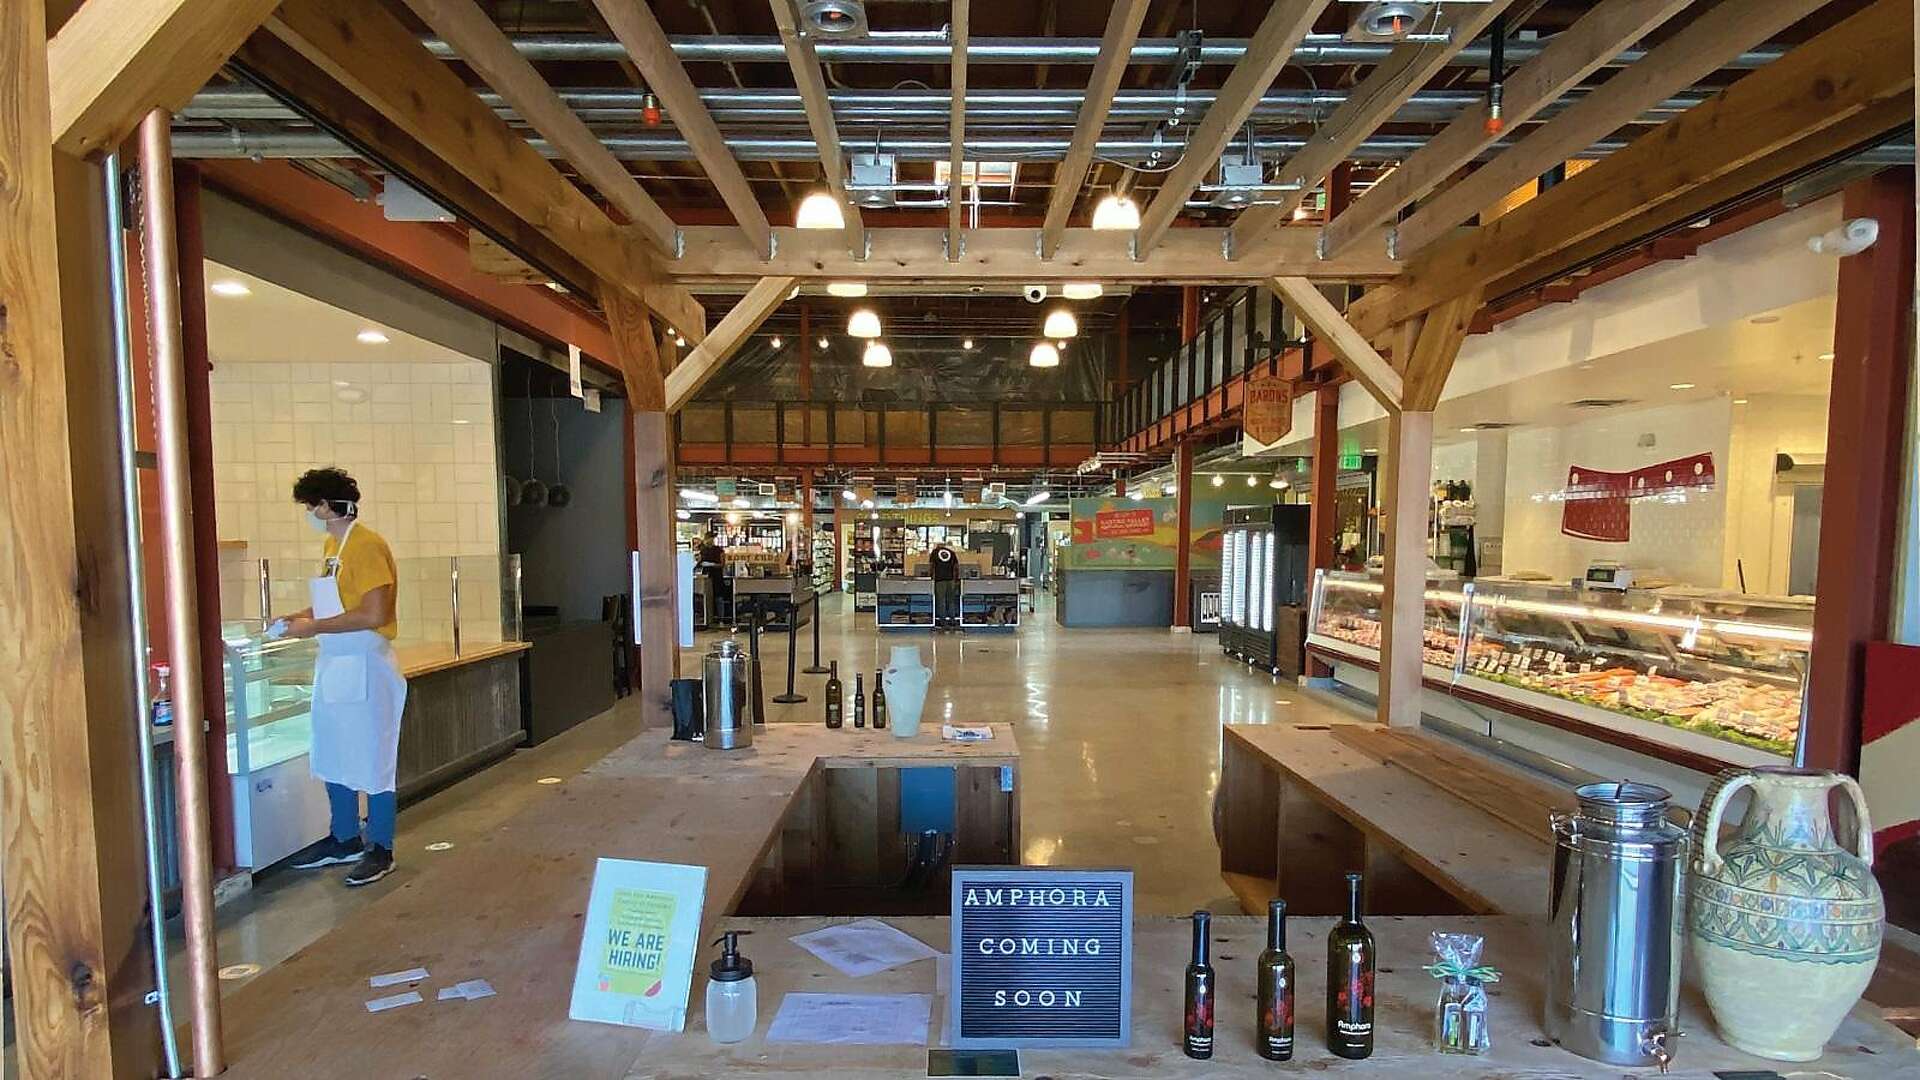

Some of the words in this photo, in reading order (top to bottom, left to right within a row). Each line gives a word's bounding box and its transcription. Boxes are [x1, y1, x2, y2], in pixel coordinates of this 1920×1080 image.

[1250, 389, 1288, 404] BARONS
[964, 889, 1110, 906] AMPHORA
[608, 928, 632, 947] WE
[635, 933, 665, 951] ARE
[980, 938, 1101, 955] COMING
[608, 950, 661, 970] HIRING!
[994, 990, 1082, 1007] SOON
